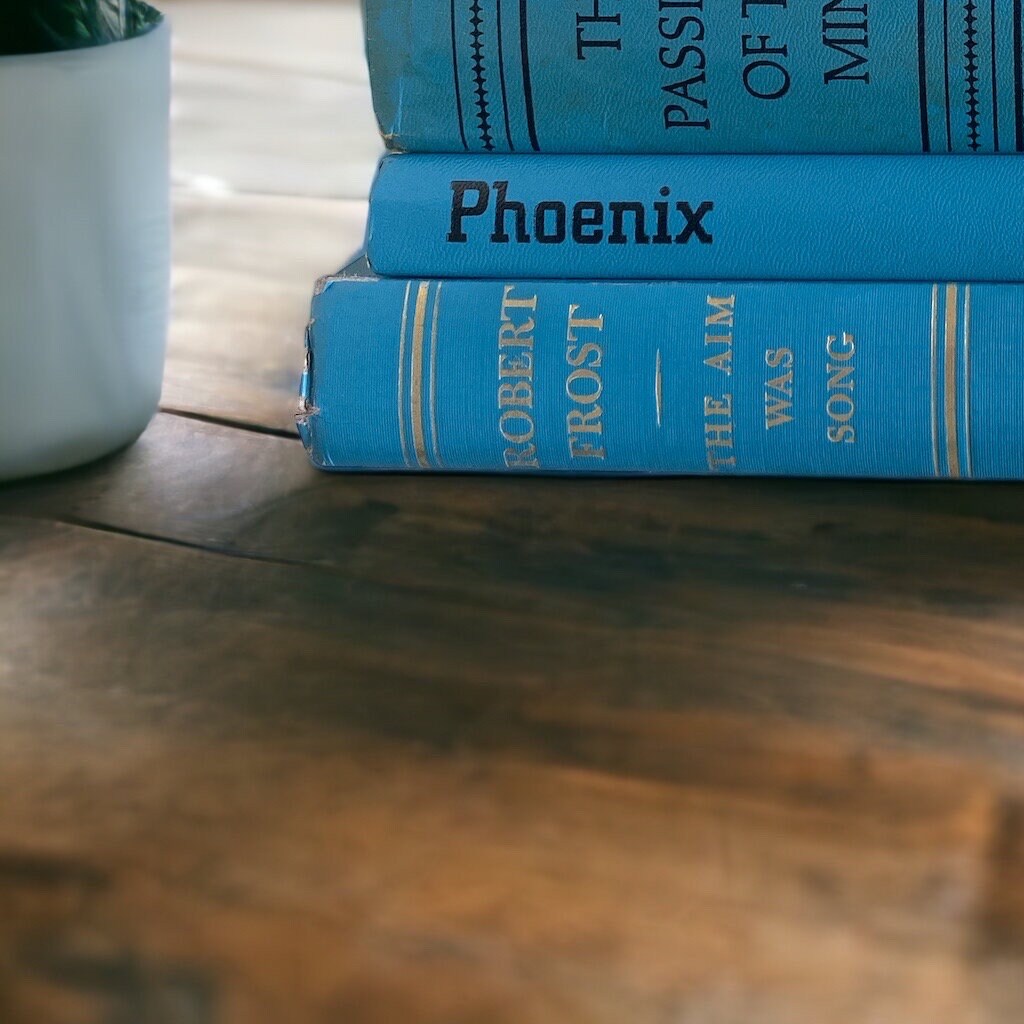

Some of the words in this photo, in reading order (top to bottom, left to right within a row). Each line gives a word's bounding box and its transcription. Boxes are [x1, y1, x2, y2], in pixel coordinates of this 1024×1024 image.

[742, 35, 790, 100] OF
[446, 180, 714, 244] Phoenix
[703, 294, 735, 376] AIM
[498, 284, 540, 469] ROBERT
[566, 304, 605, 460] FROST
[765, 347, 795, 429] WAS
[826, 332, 855, 444] SONG
[704, 393, 736, 470] THE
